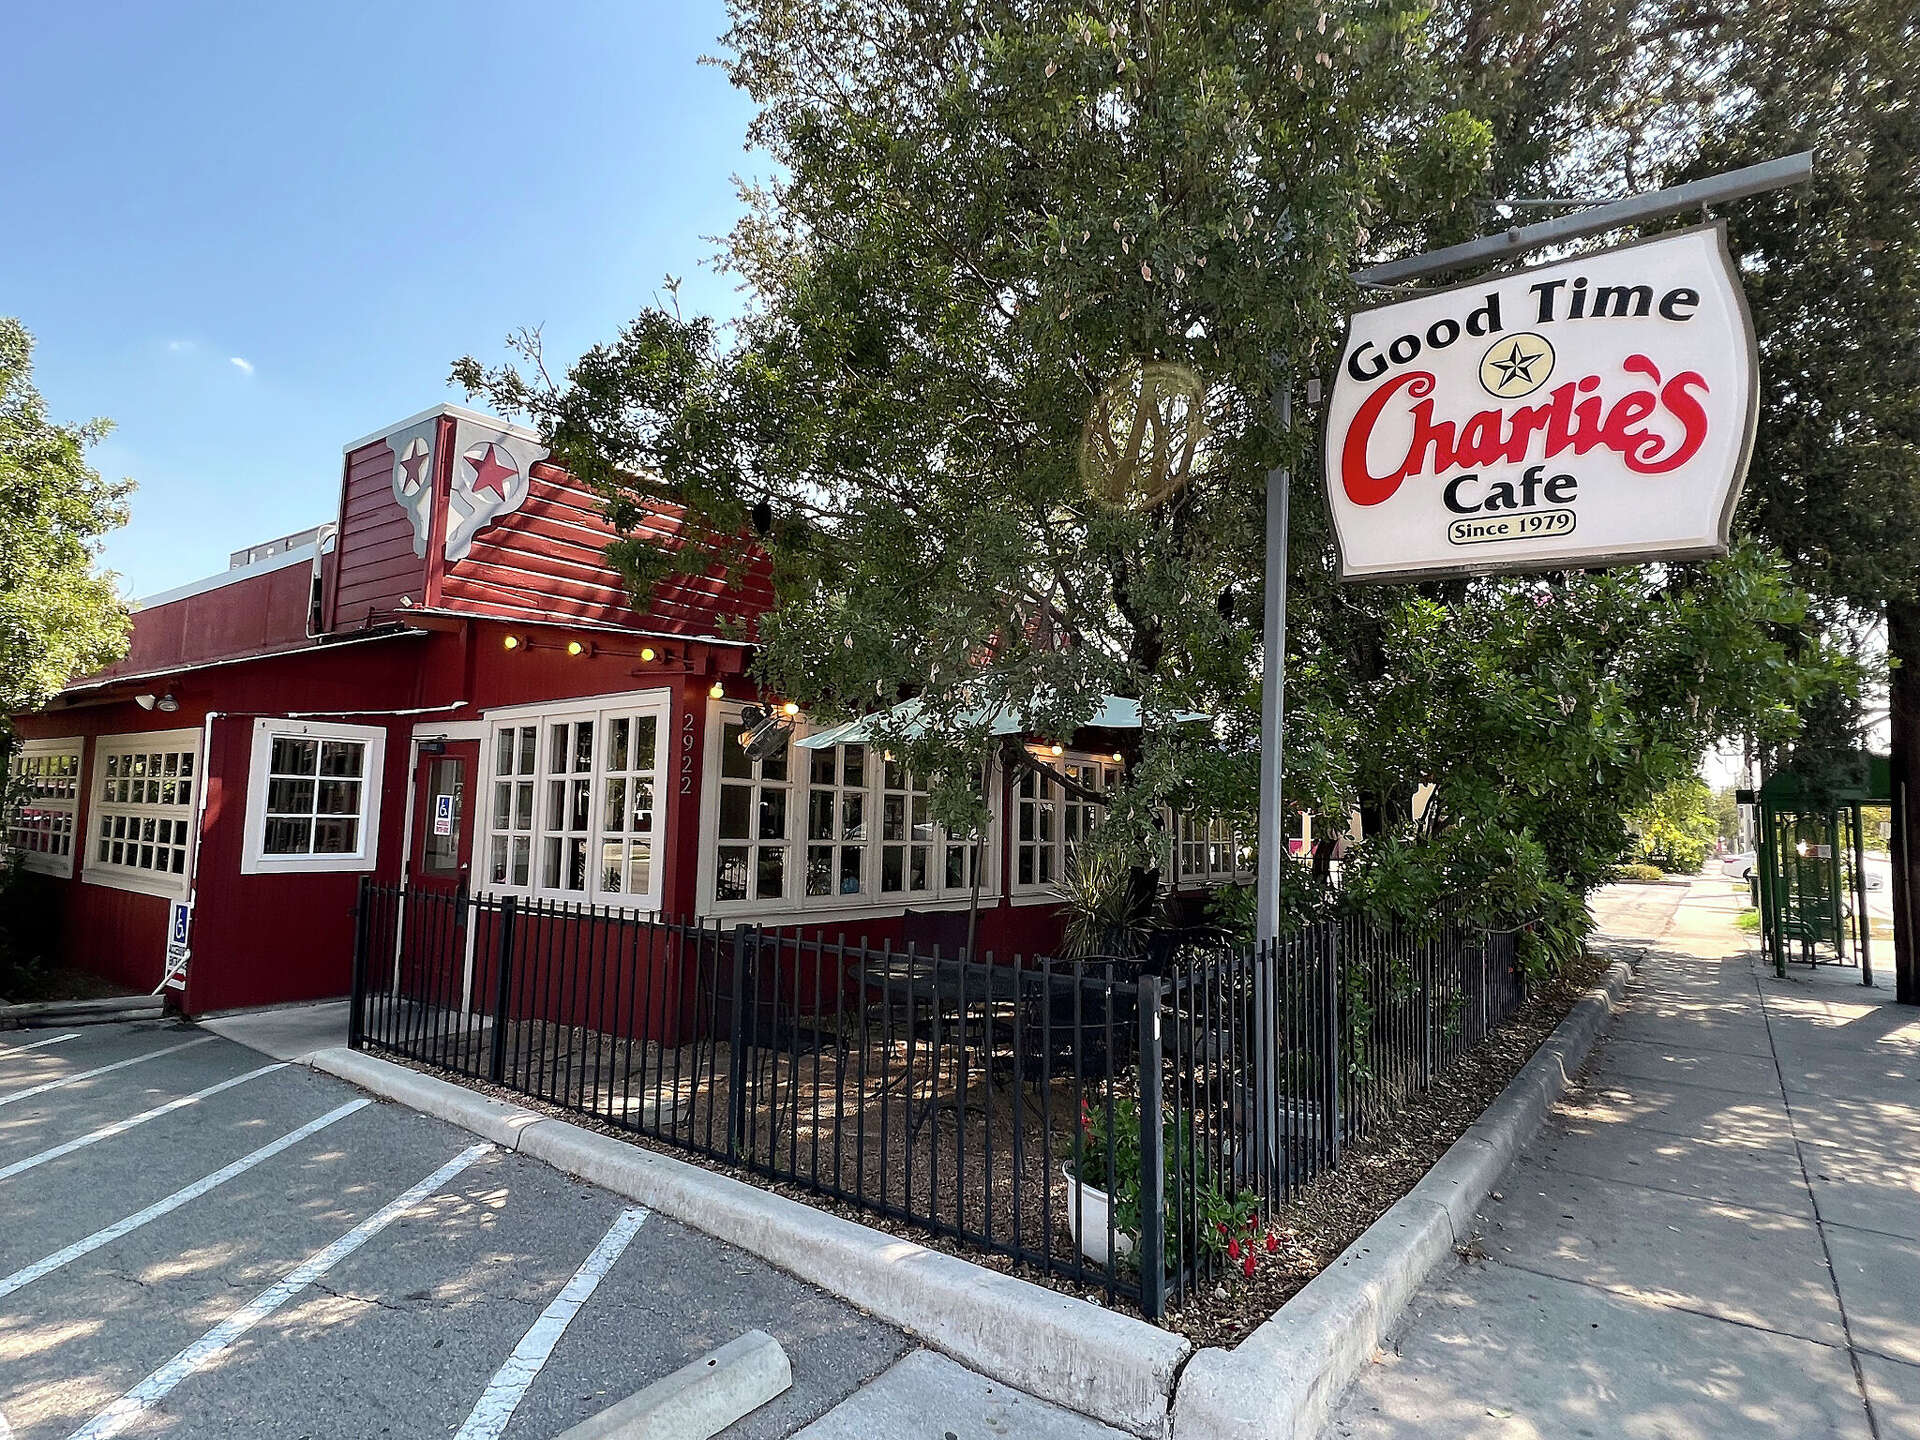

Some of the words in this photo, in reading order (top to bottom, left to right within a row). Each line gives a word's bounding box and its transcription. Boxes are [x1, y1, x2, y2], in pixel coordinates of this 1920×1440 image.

[1347, 292, 1505, 382] Good
[1528, 276, 1700, 324] Time
[1442, 465, 1578, 514] Cafe
[1454, 519, 1509, 539] Since
[1518, 514, 1570, 535] 1979
[680, 713, 695, 794] 2922
